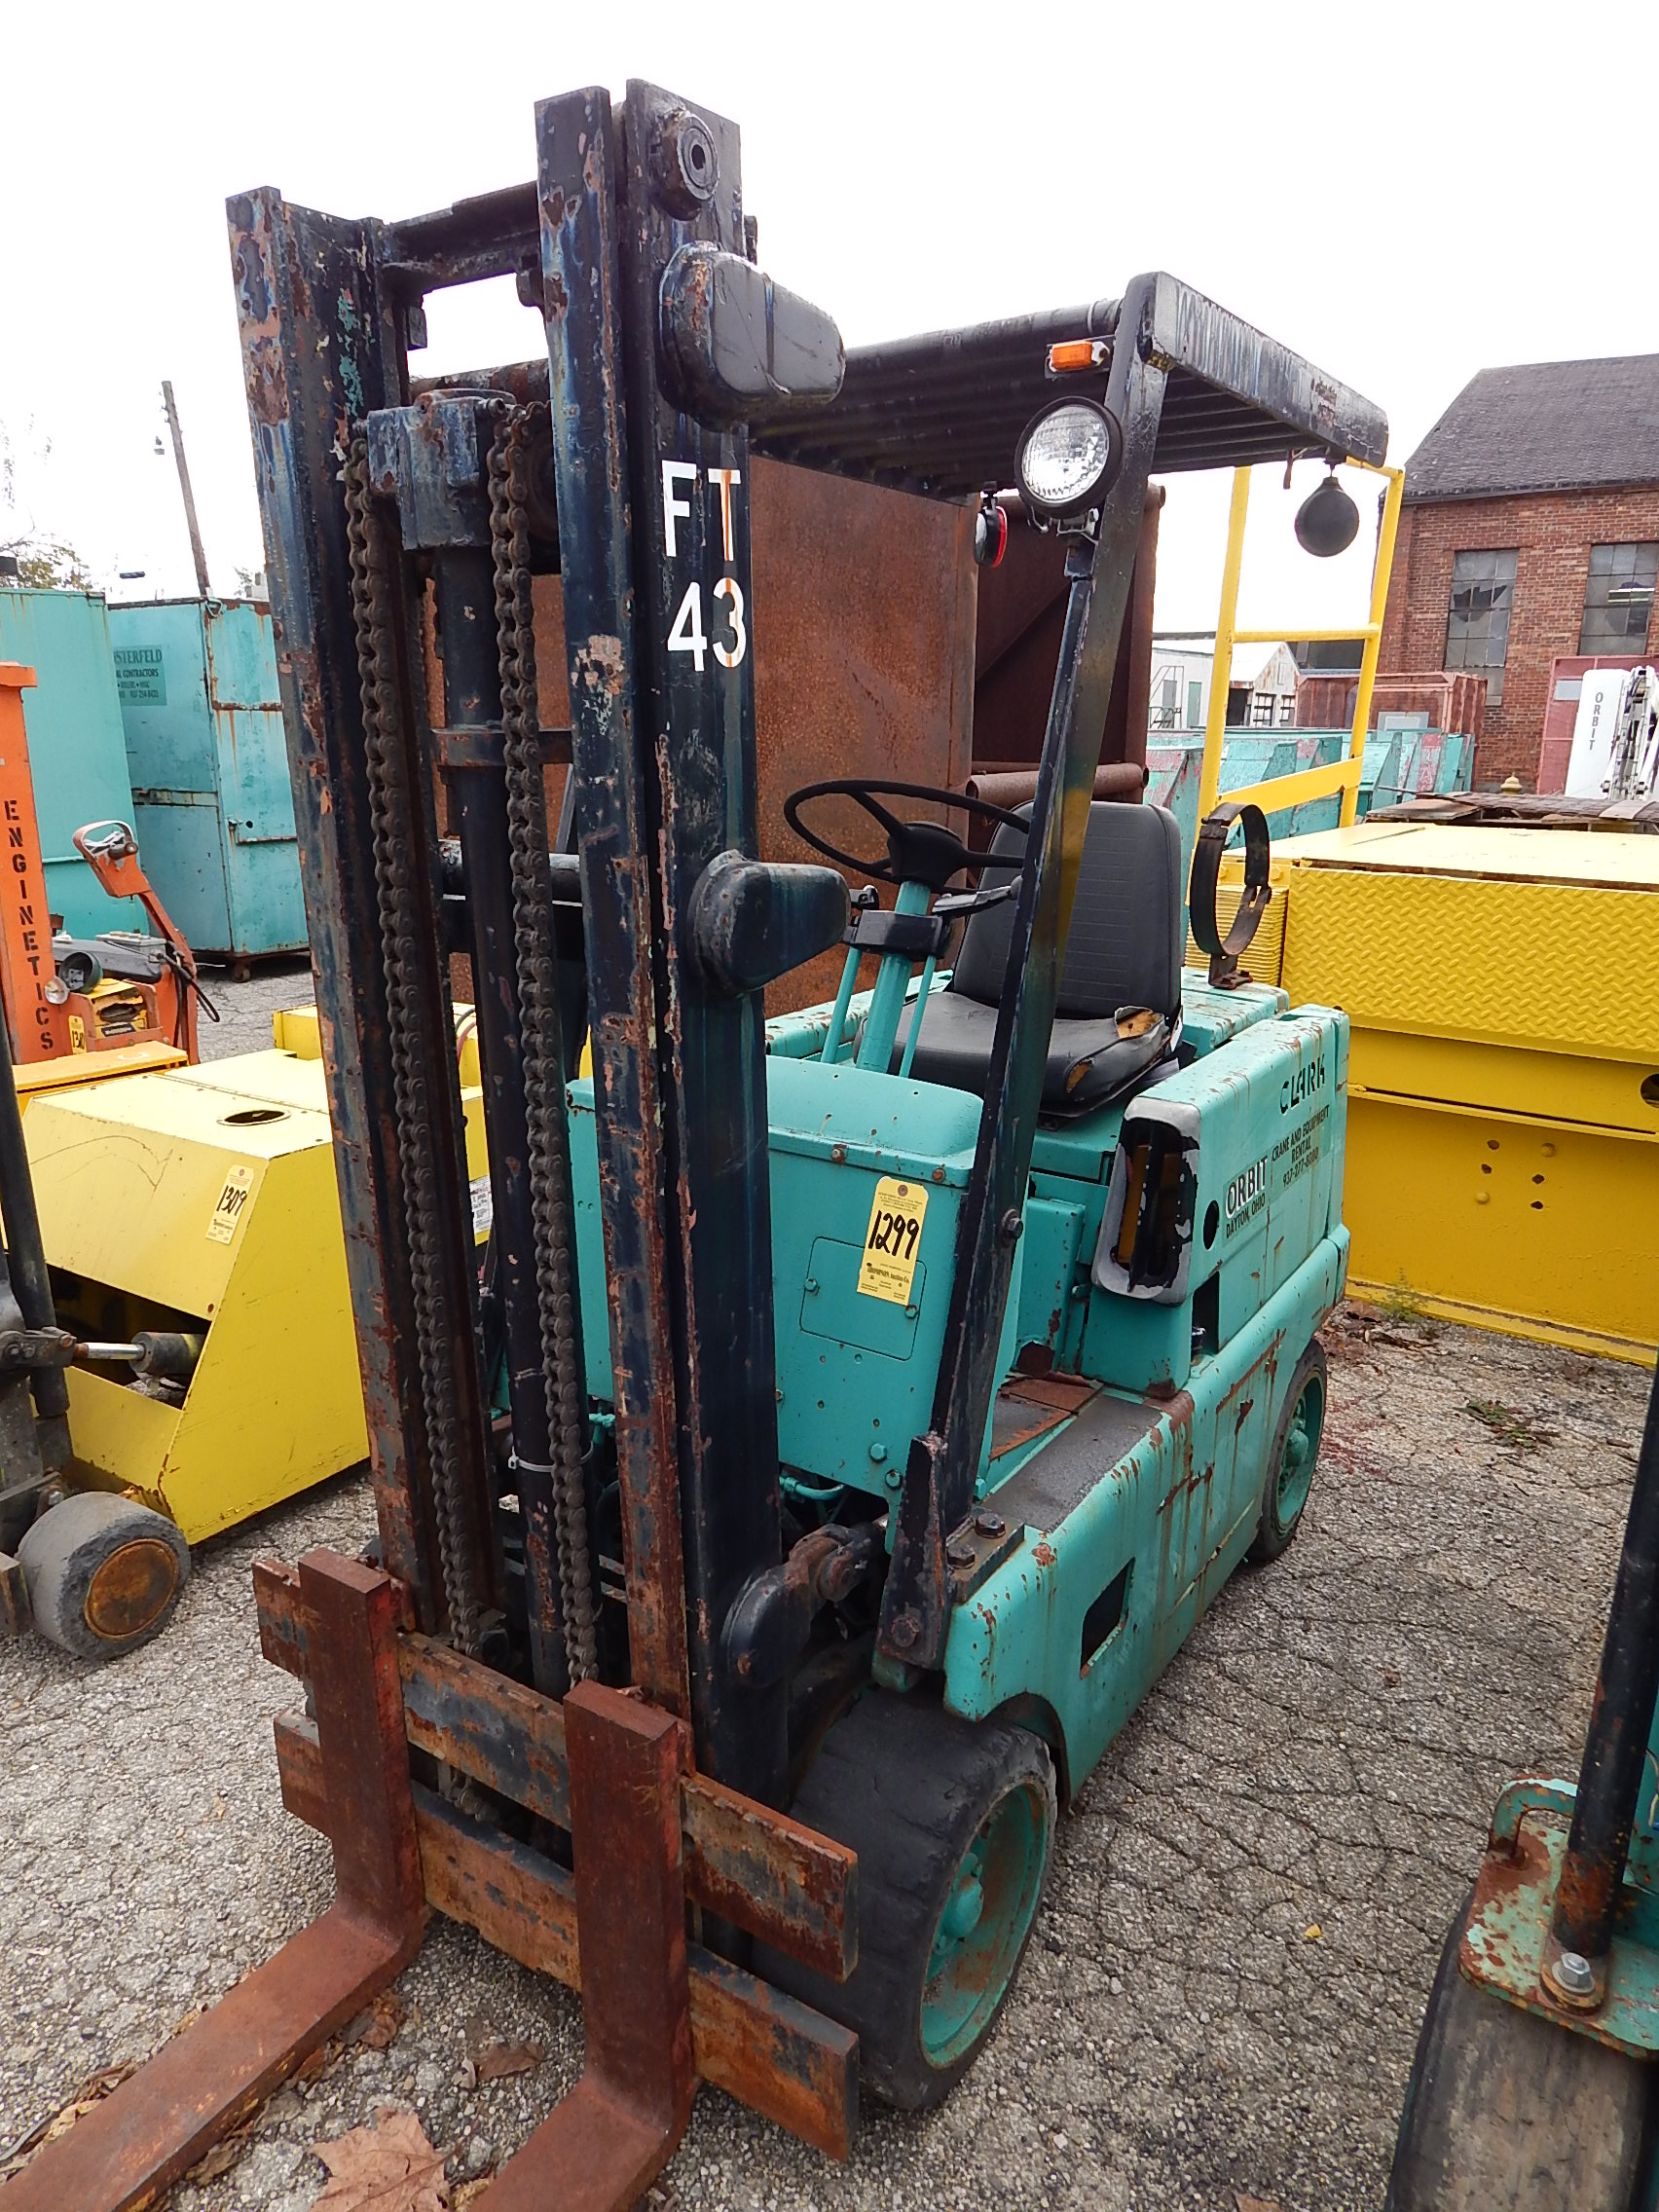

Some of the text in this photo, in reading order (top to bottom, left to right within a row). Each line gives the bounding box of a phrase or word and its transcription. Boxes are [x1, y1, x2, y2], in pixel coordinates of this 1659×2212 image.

[662, 460, 741, 562] FT
[668, 577, 747, 672] 43
[1589, 691, 1604, 751] ORBIT
[4, 799, 55, 1051] ENGINETICS
[1279, 1053, 1325, 1115] CLARK
[1272, 1104, 1330, 1162] CRANE AND EQUIPMENT
[1292, 1135, 1311, 1164] RENTAL
[215, 1185, 248, 1216] 1309
[1226, 1155, 1268, 1219] ORBIT
[1251, 1192, 1266, 1216] OHIO
[867, 1209, 920, 1261] 1299
